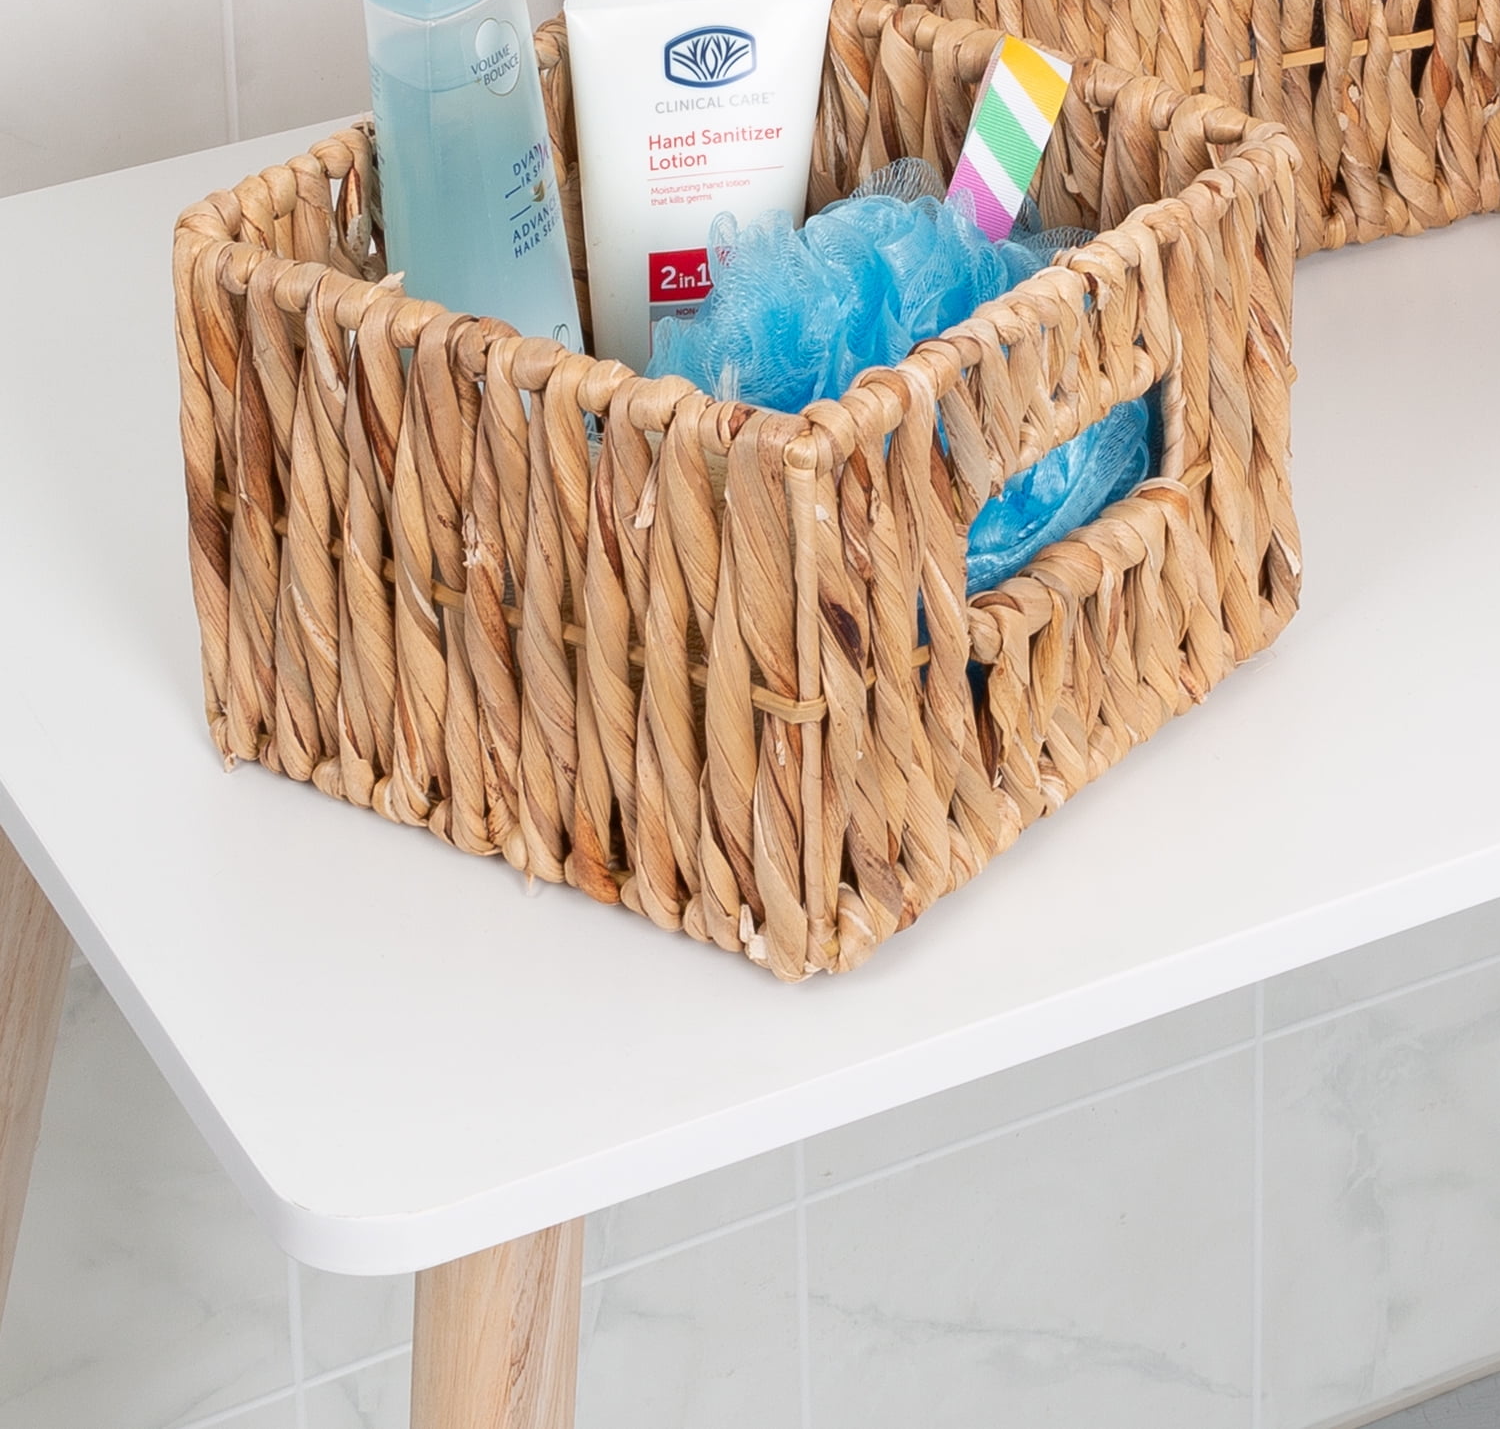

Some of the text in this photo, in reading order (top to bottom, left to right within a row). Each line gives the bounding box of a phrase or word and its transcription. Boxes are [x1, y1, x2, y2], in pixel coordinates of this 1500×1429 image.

[471, 44, 510, 75] VOLUME
[483, 53, 519, 86] BOUNCE
[655, 96, 725, 114] CLINICAL
[649, 126, 783, 151] Hand Sanitizer
[649, 152, 707, 171] Lotion
[650, 179, 750, 195] Moisturizing hand lotion
[650, 193, 712, 206] that kills germs
[514, 232, 541, 259] HAIR
